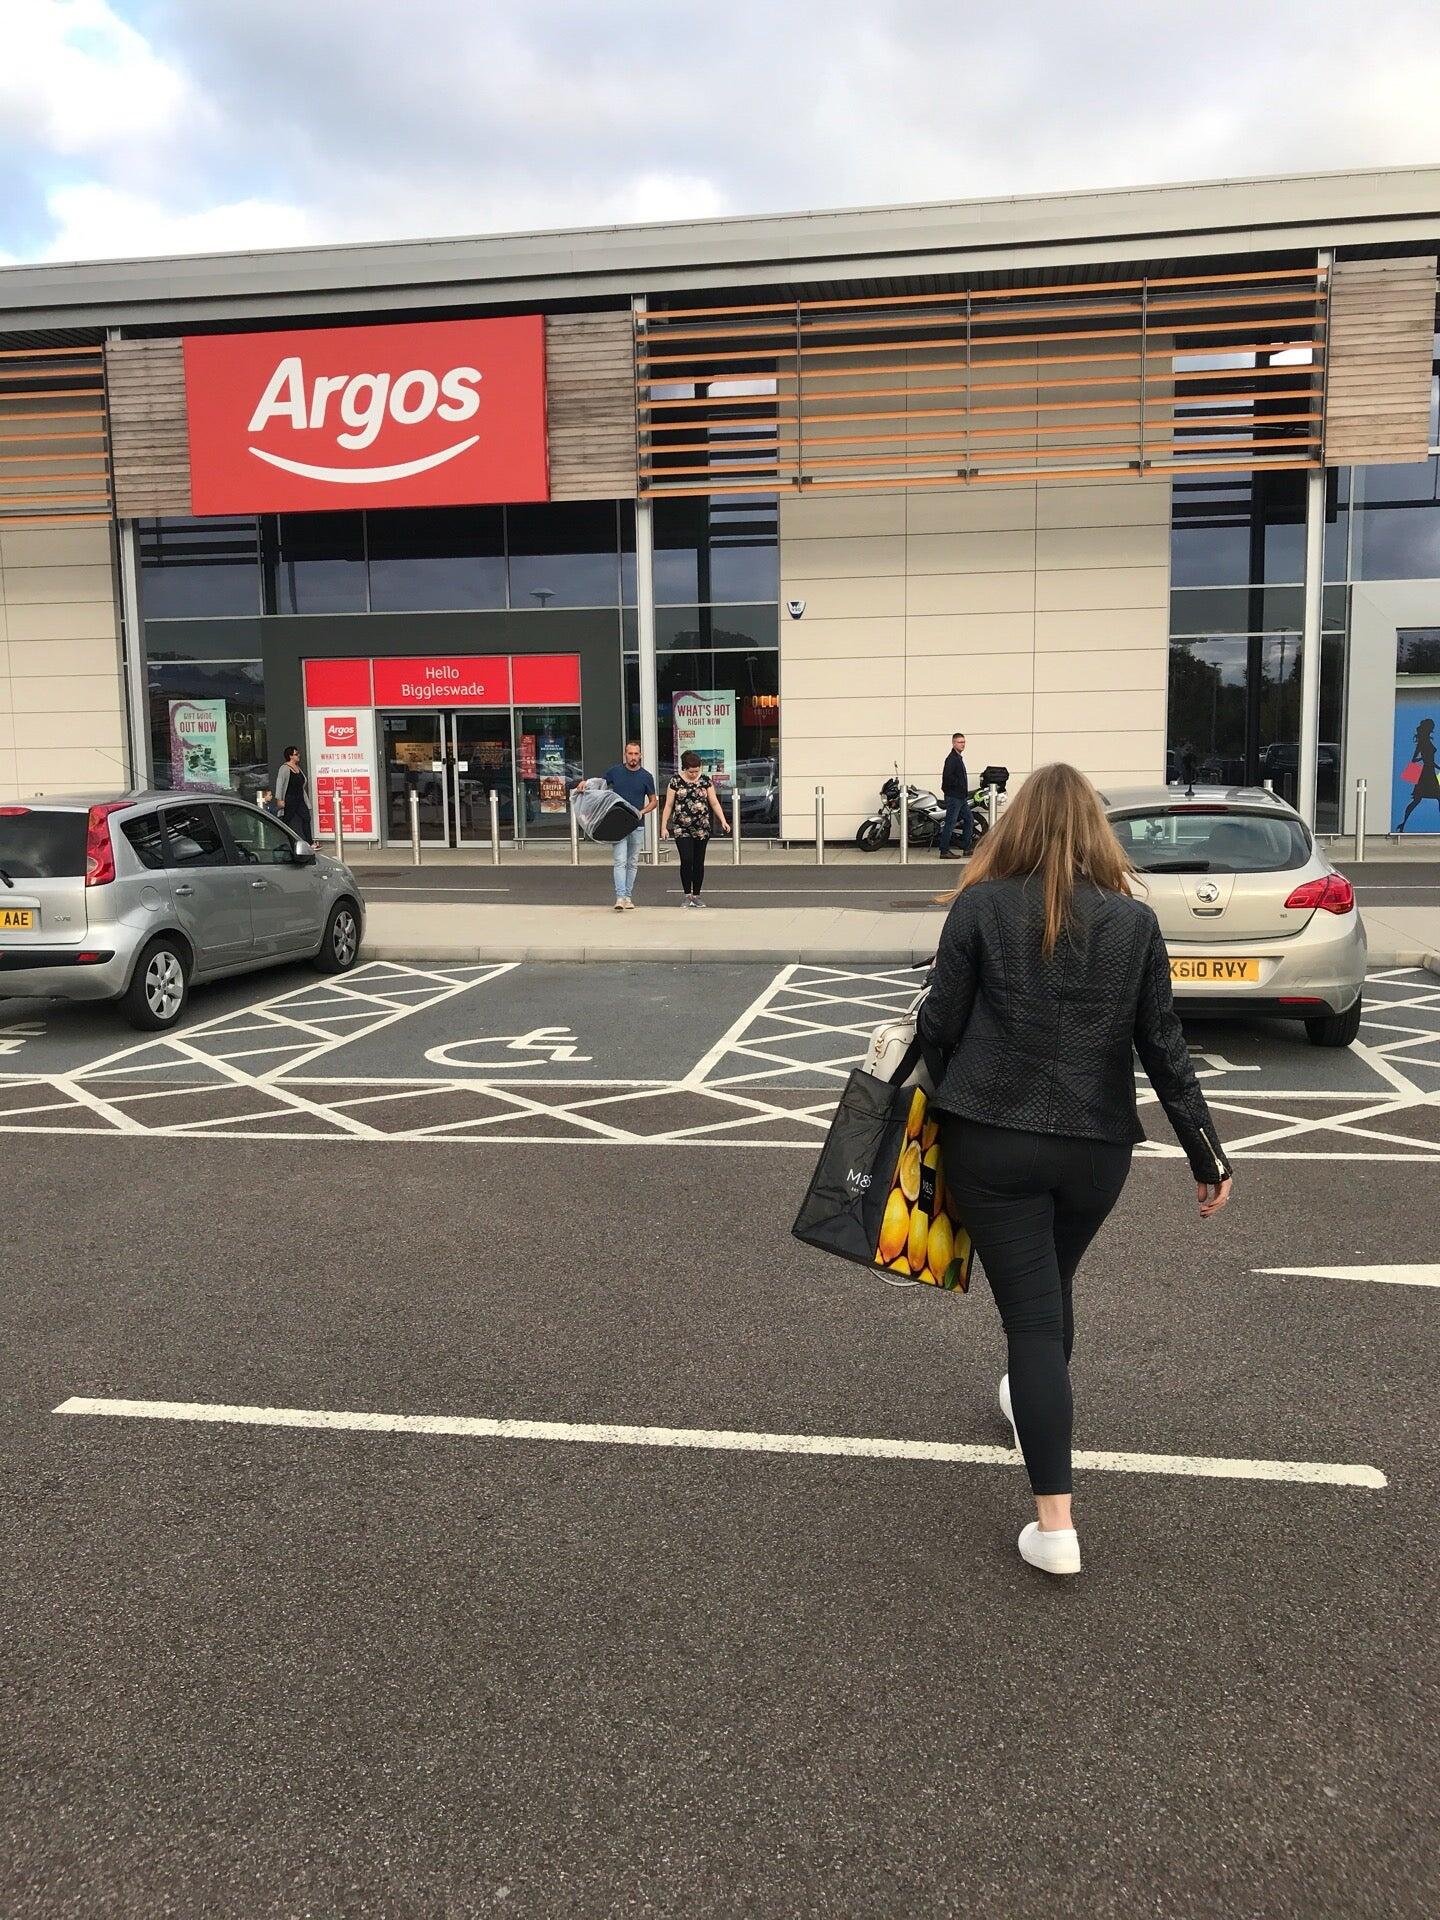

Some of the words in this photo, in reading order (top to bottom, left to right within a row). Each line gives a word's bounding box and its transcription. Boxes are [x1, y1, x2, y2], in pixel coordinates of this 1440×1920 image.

[248, 356, 483, 450] Argos
[425, 666, 460, 679] Hello
[402, 682, 485, 699] Biggleswade
[183, 712, 195, 720] GIFT
[196, 712, 212, 720] GUIDE
[677, 704, 711, 717] WHAT'S
[714, 704, 731, 716] HOT
[180, 722, 195, 733] OUT
[198, 721, 217, 732] NOW
[687, 718, 705, 726] RIGHT
[707, 717, 721, 725] NOW
[328, 725, 355, 736] Argos
[4, 911, 29, 926] AAE
[1212, 961, 1248, 978] RVY
